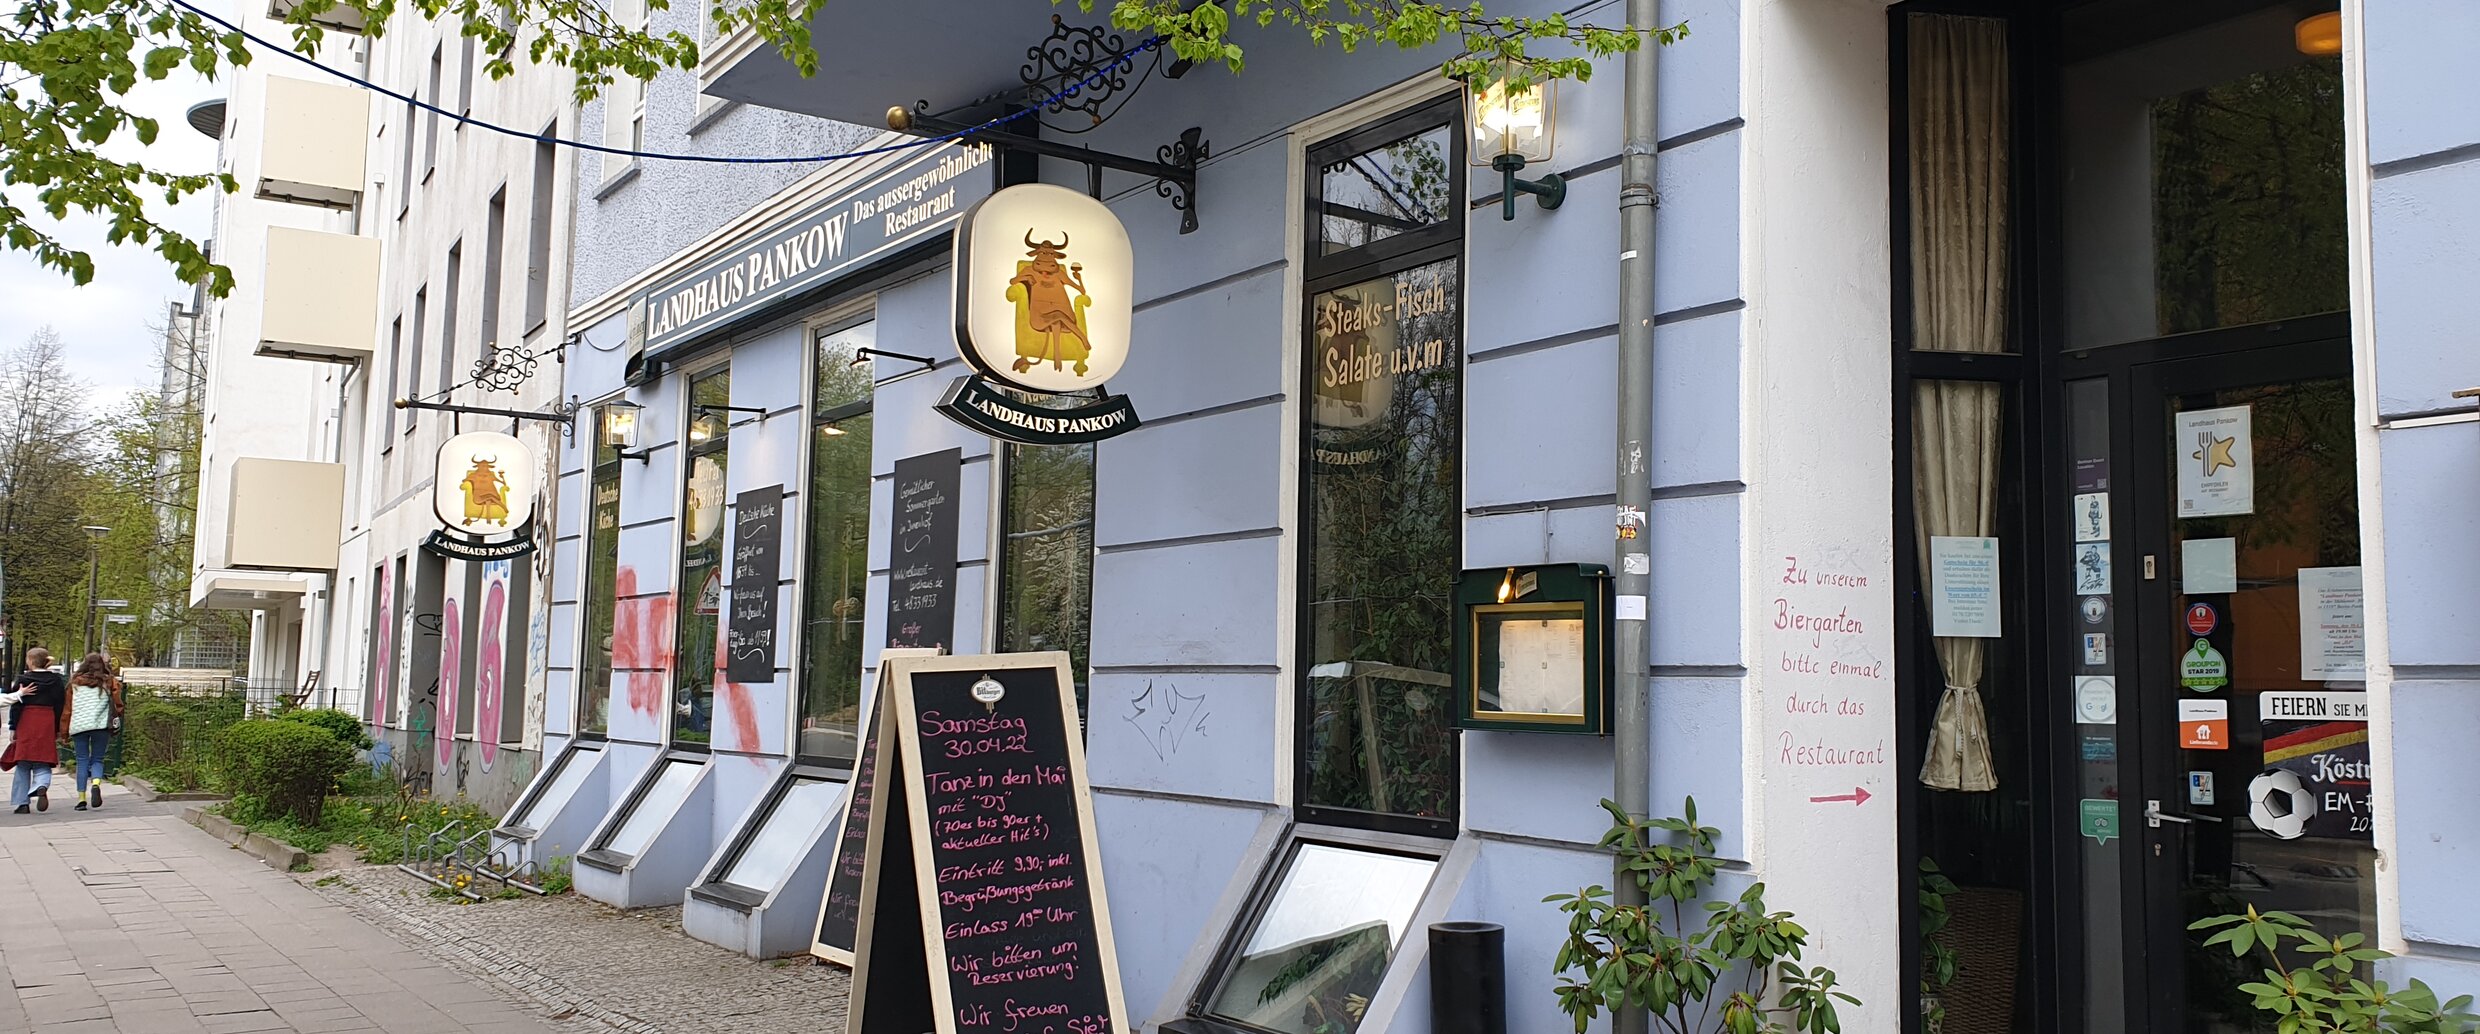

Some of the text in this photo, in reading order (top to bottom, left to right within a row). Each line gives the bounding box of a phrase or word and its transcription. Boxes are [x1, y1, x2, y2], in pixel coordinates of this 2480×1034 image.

[853, 198, 875, 225] Das
[885, 187, 956, 237] Restaurant
[647, 262, 746, 341] LANDHAUS
[747, 211, 849, 297] PANKOW
[1324, 338, 1443, 388] Salate u.v.m
[966, 389, 1127, 433] LANDHAUS PANKOW
[435, 537, 530, 556] LANDHAUS PANKOW
[1783, 556, 1868, 588] Zu unserem
[1773, 598, 1864, 648] Biergarten
[1781, 650, 1882, 680] bitte einmal
[2186, 660, 2221, 668] GROUPON
[1786, 691, 1864, 716] durch das
[2271, 697, 2327, 716] FEIERN
[2333, 703, 2351, 717] SIE
[921, 710, 1027, 740] Samstag
[944, 735, 1034, 759] 30.04.22
[1778, 730, 1885, 767] Restaurant
[926, 764, 1067, 795] Tanz in den Mai
[938, 797, 967, 815] mit
[977, 815, 998, 828] bis
[941, 833, 1007, 850] aktueller
[938, 858, 1005, 883] Eintritt
[939, 875, 1075, 912] Begrüßungsgetränk
[945, 919, 1009, 939] Einlass
[1046, 906, 1079, 923] Uhr
[951, 940, 1078, 972] Wir bitten um
[960, 998, 1069, 1032] Wir freuen
